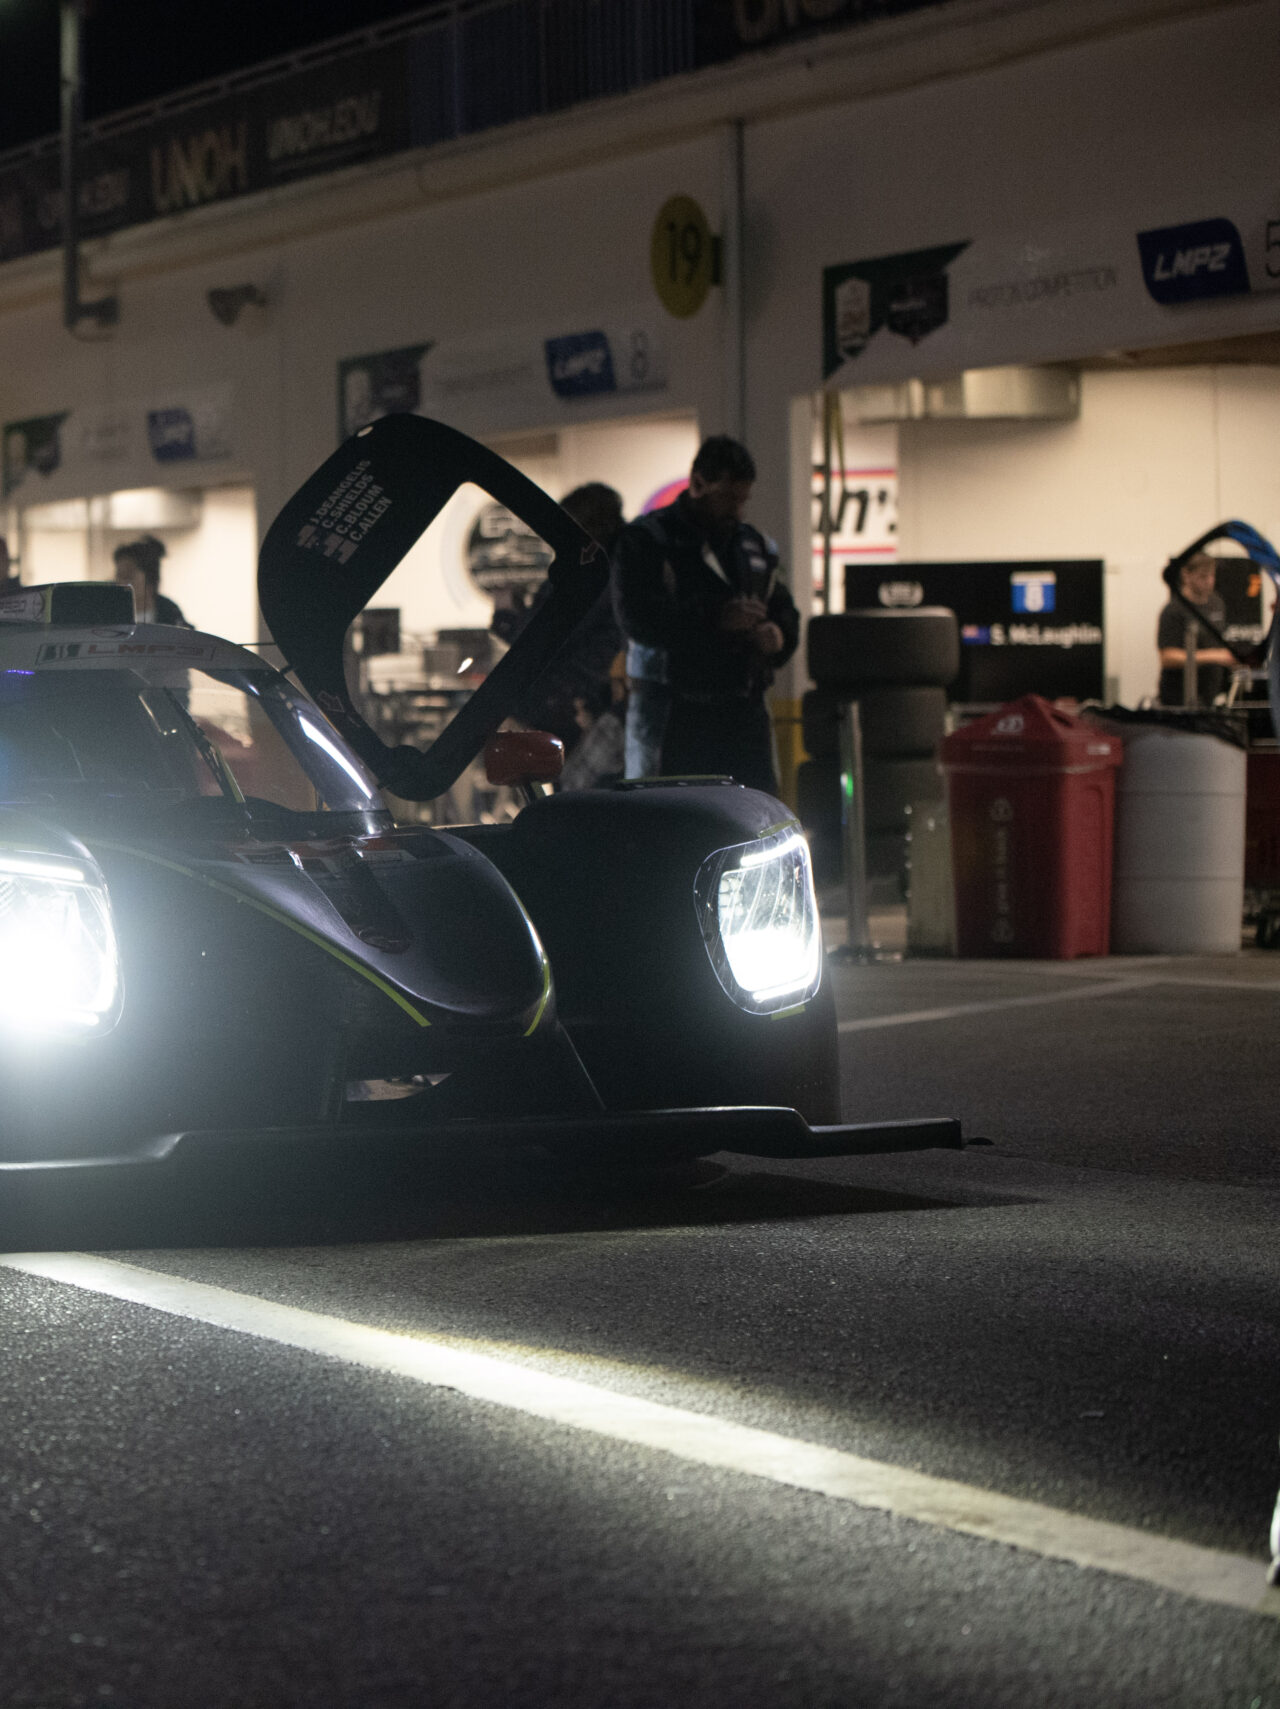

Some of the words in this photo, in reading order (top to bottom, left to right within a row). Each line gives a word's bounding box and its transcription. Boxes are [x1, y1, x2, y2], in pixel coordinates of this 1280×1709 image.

[151, 119, 248, 215] UNOH
[665, 220, 703, 285] 19
[1152, 242, 1232, 282] LMP2
[322, 473, 374, 529] C.SHIELDS
[335, 484, 384, 534] C.BLOUM
[350, 496, 393, 542] C.ALLEN
